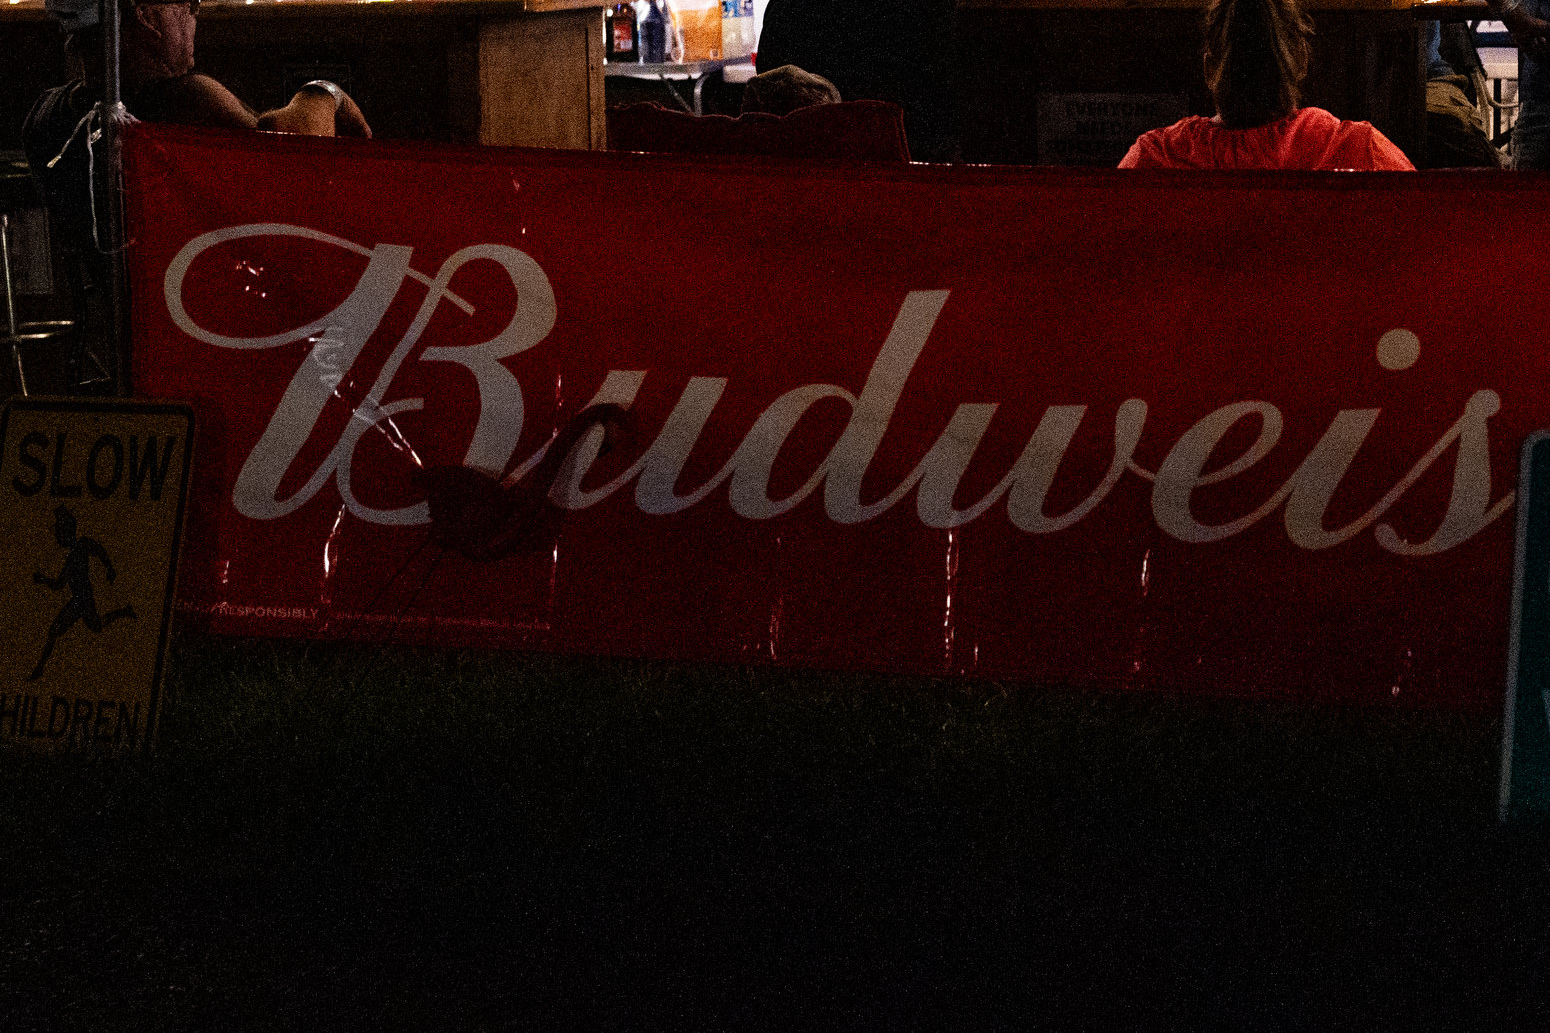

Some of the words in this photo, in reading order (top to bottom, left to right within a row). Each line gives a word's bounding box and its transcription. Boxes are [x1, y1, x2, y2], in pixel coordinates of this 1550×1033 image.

[11, 430, 176, 502] SLOW
[211, 603, 319, 619] RESPONSIBLY
[0, 694, 140, 749] HILDREN
